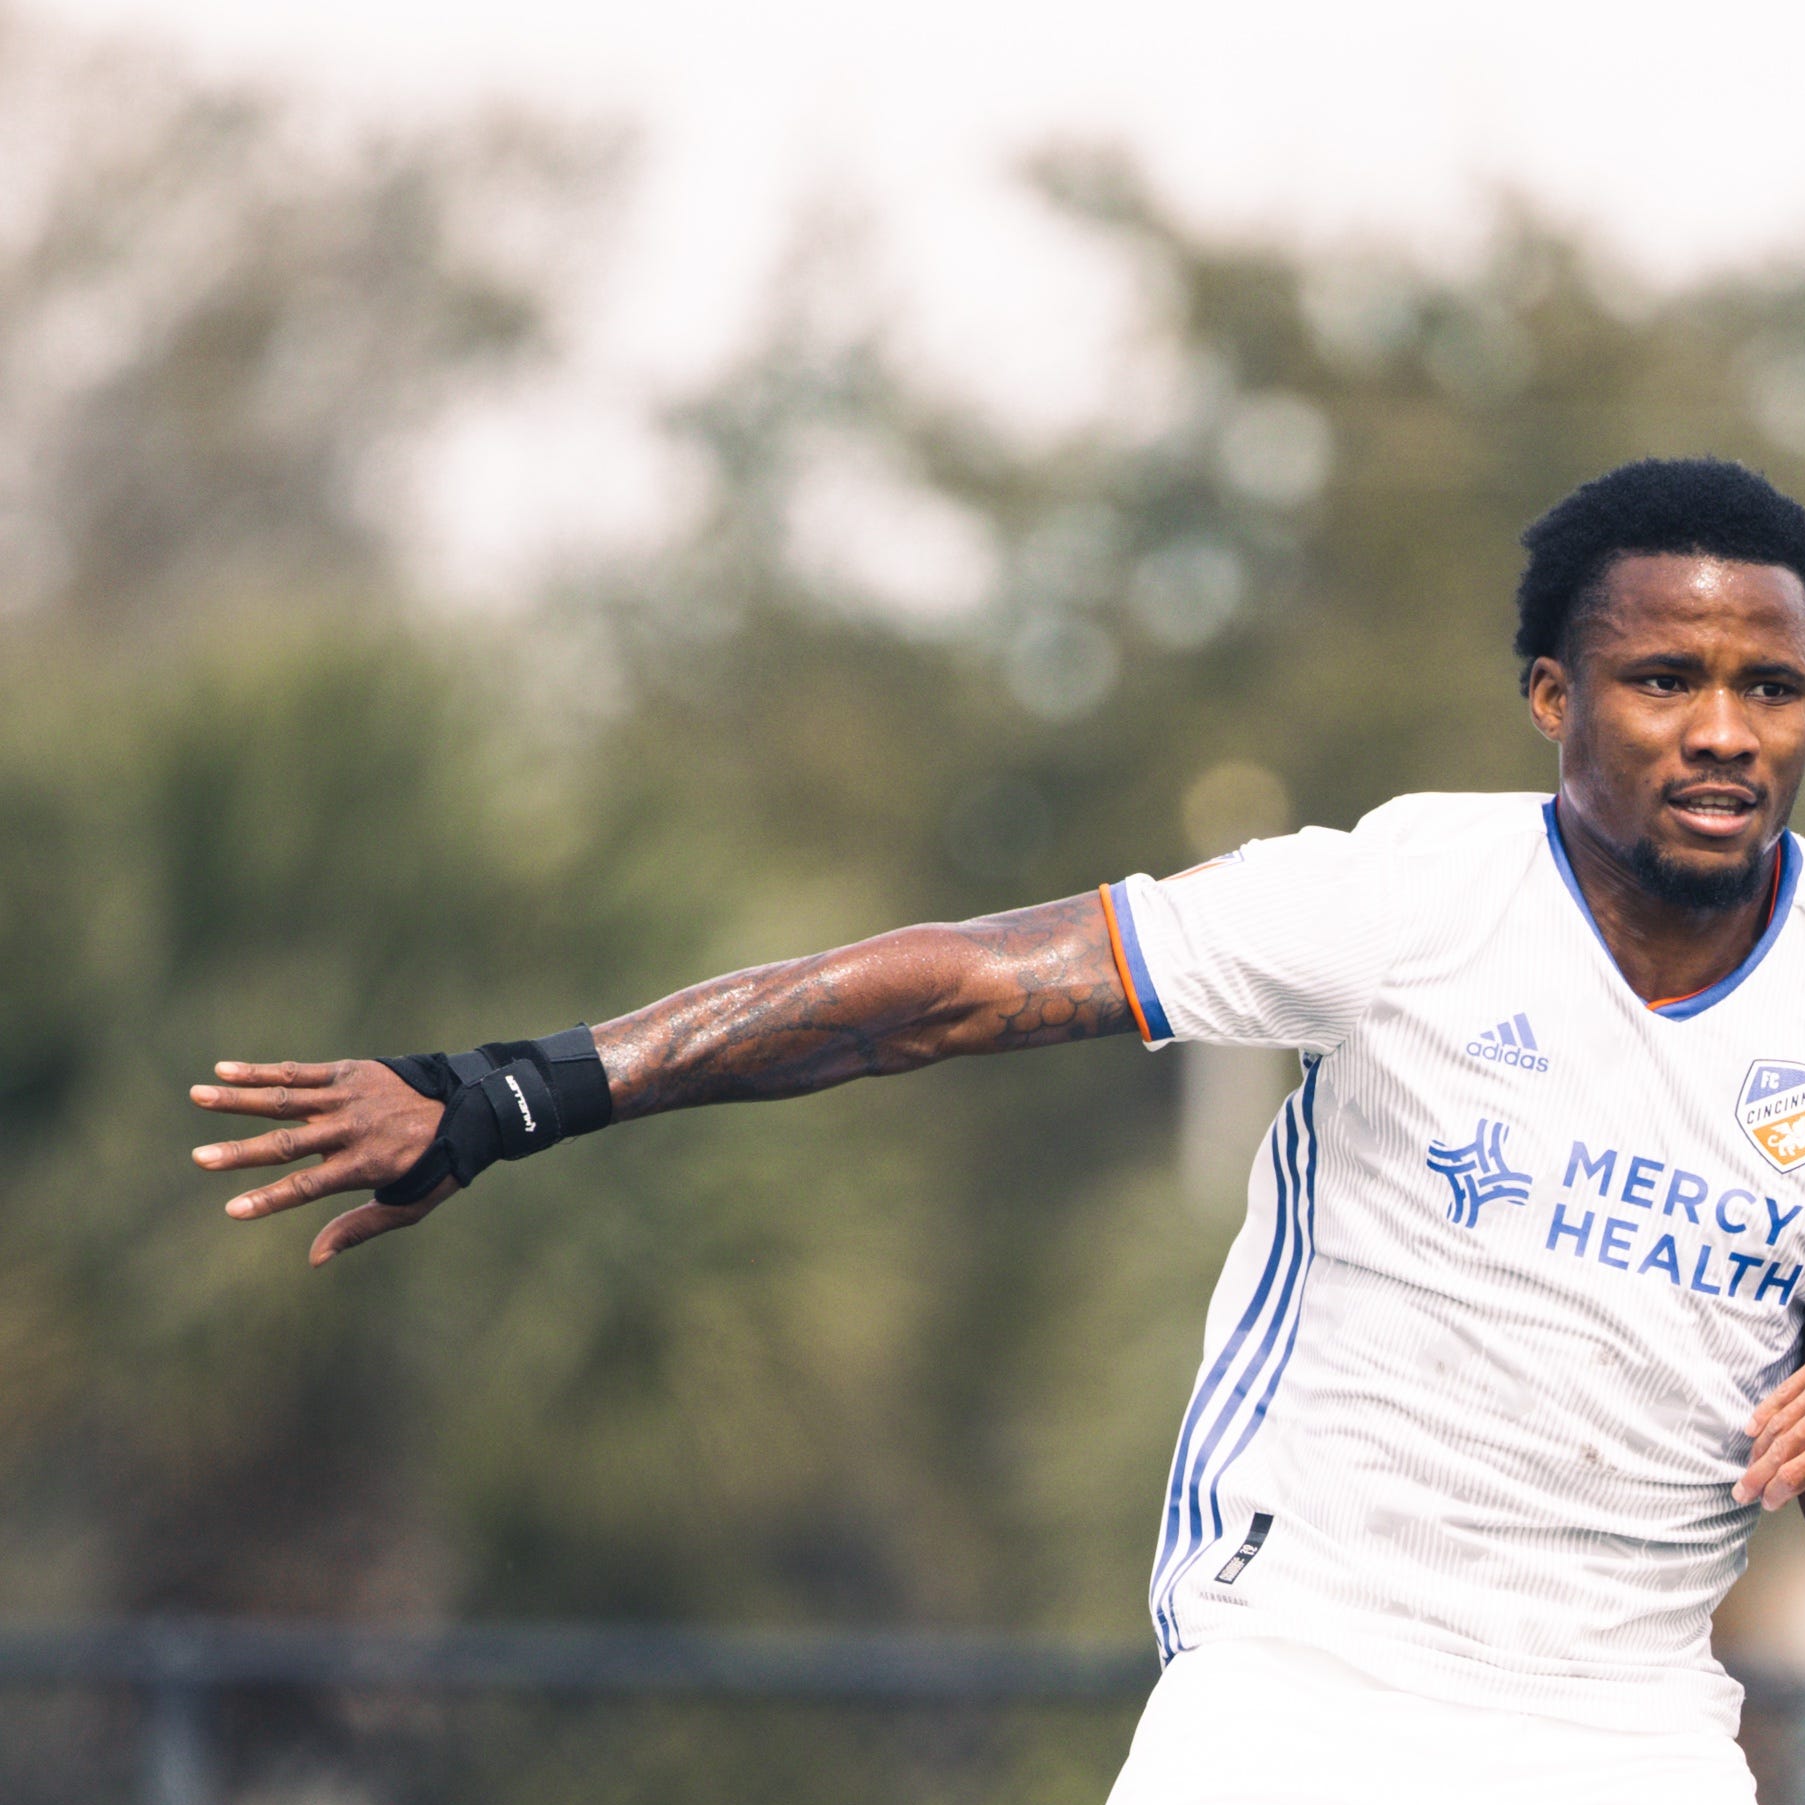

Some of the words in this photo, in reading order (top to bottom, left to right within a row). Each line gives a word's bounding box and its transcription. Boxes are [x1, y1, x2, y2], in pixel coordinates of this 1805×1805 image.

[1466, 1042, 1549, 1073] adidas
[1760, 1070, 1780, 1090] FC
[1562, 1140, 1803, 1246] MERCY
[1545, 1204, 1804, 1306] HEALTH
